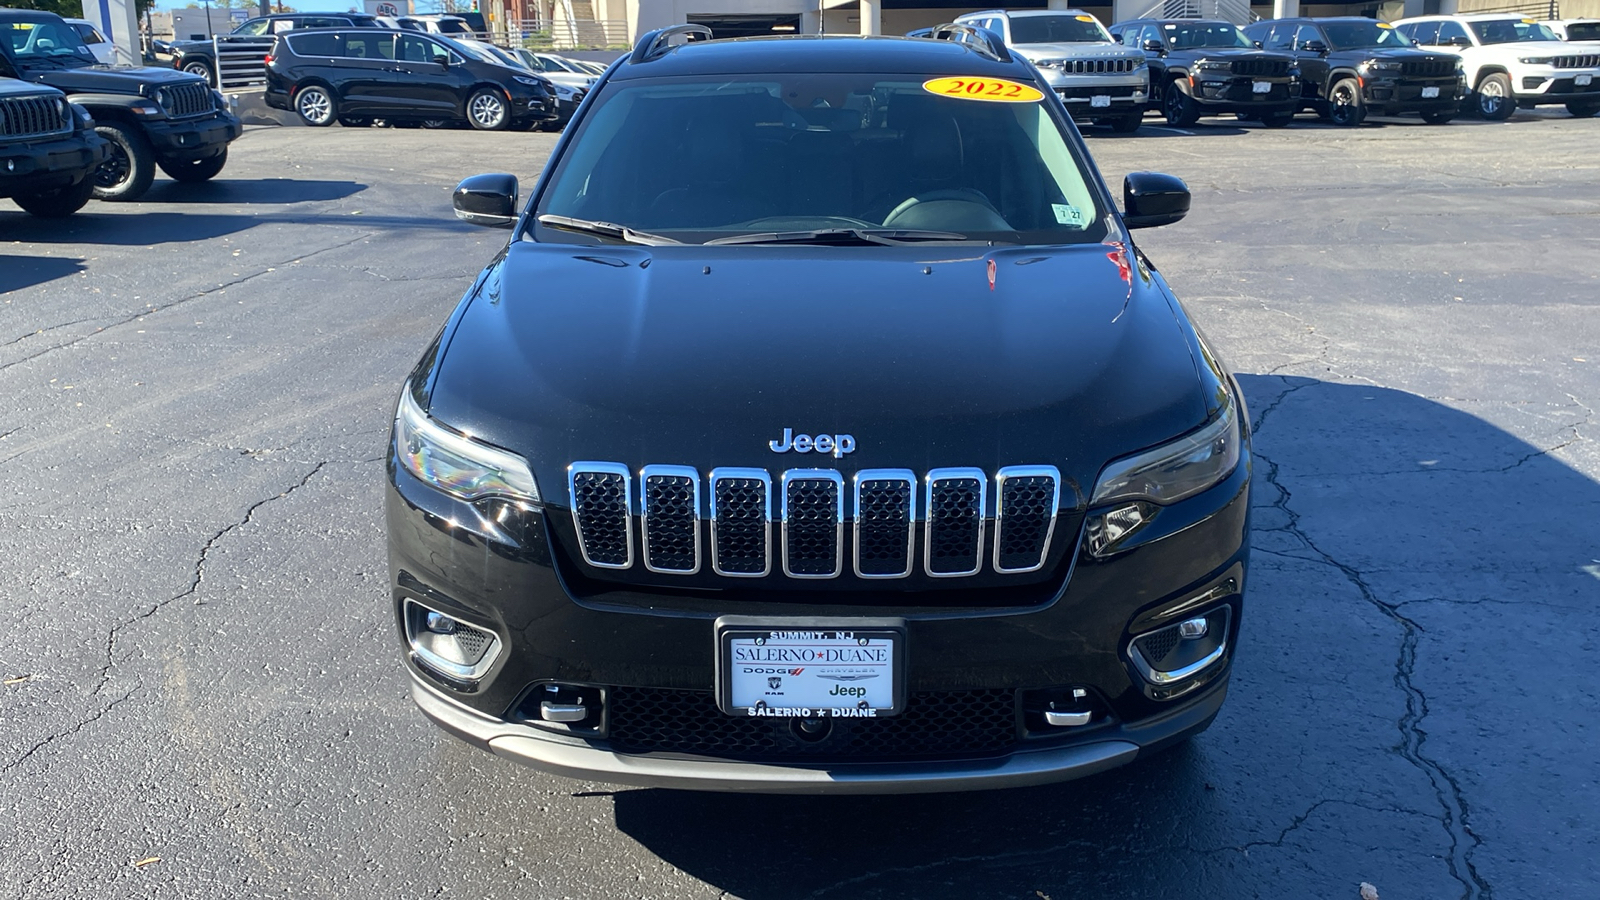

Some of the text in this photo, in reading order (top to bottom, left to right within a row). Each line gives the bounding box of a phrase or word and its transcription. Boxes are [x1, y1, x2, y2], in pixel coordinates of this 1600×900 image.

[945, 80, 1022, 98] 2022
[768, 427, 856, 459] Jeep
[835, 631, 855, 640] NJ
[735, 648, 888, 662] SALERNO DUANE
[828, 684, 867, 698] Jeep
[747, 707, 877, 718] SALERNO DUANE
